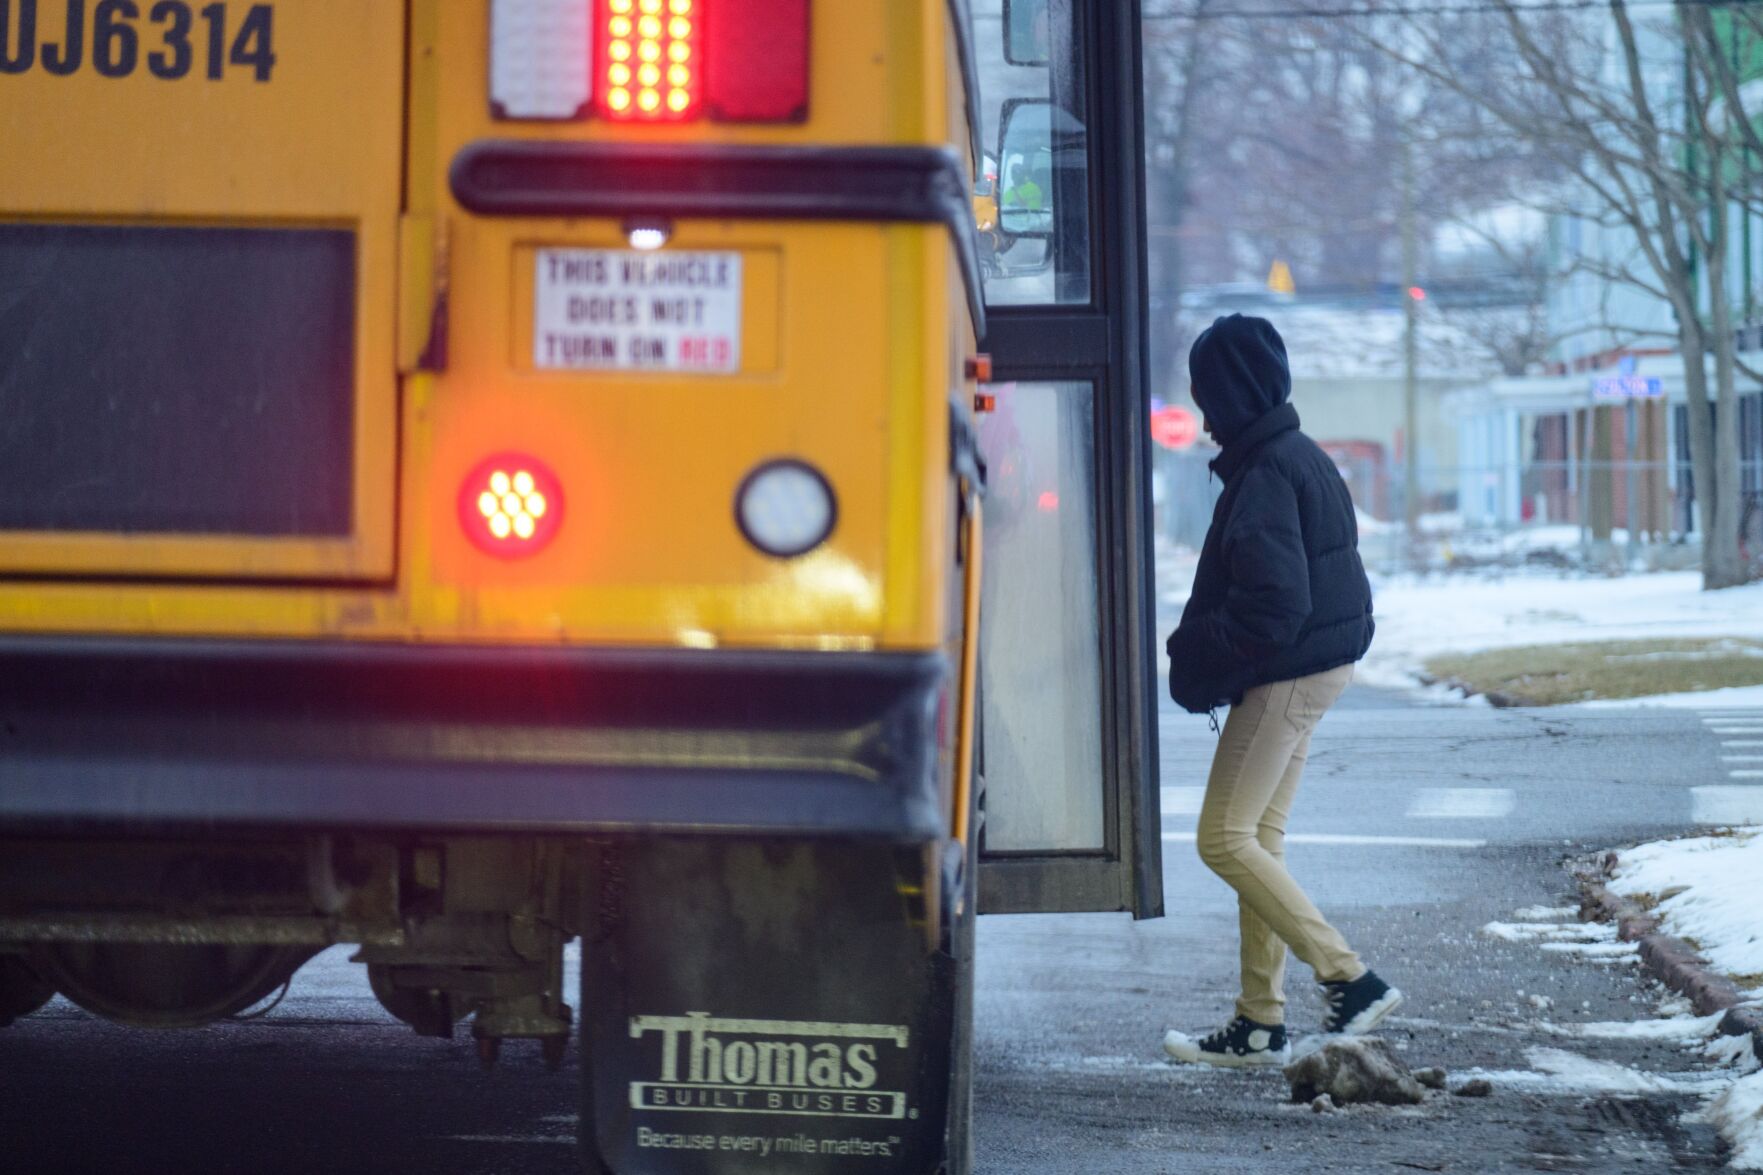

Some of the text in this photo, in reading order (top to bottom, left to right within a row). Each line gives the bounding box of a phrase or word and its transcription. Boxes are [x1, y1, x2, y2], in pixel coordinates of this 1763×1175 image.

[548, 255, 729, 288] THIS VEHICLE
[567, 296, 704, 326] DOES NOT
[546, 333, 731, 366] TURN ON RED
[629, 1011, 909, 1089] Thomas
[652, 1088, 883, 1113] BUILT BUSES
[637, 1126, 714, 1150] Because
[719, 1133, 770, 1157] every
[775, 1133, 817, 1153] mile
